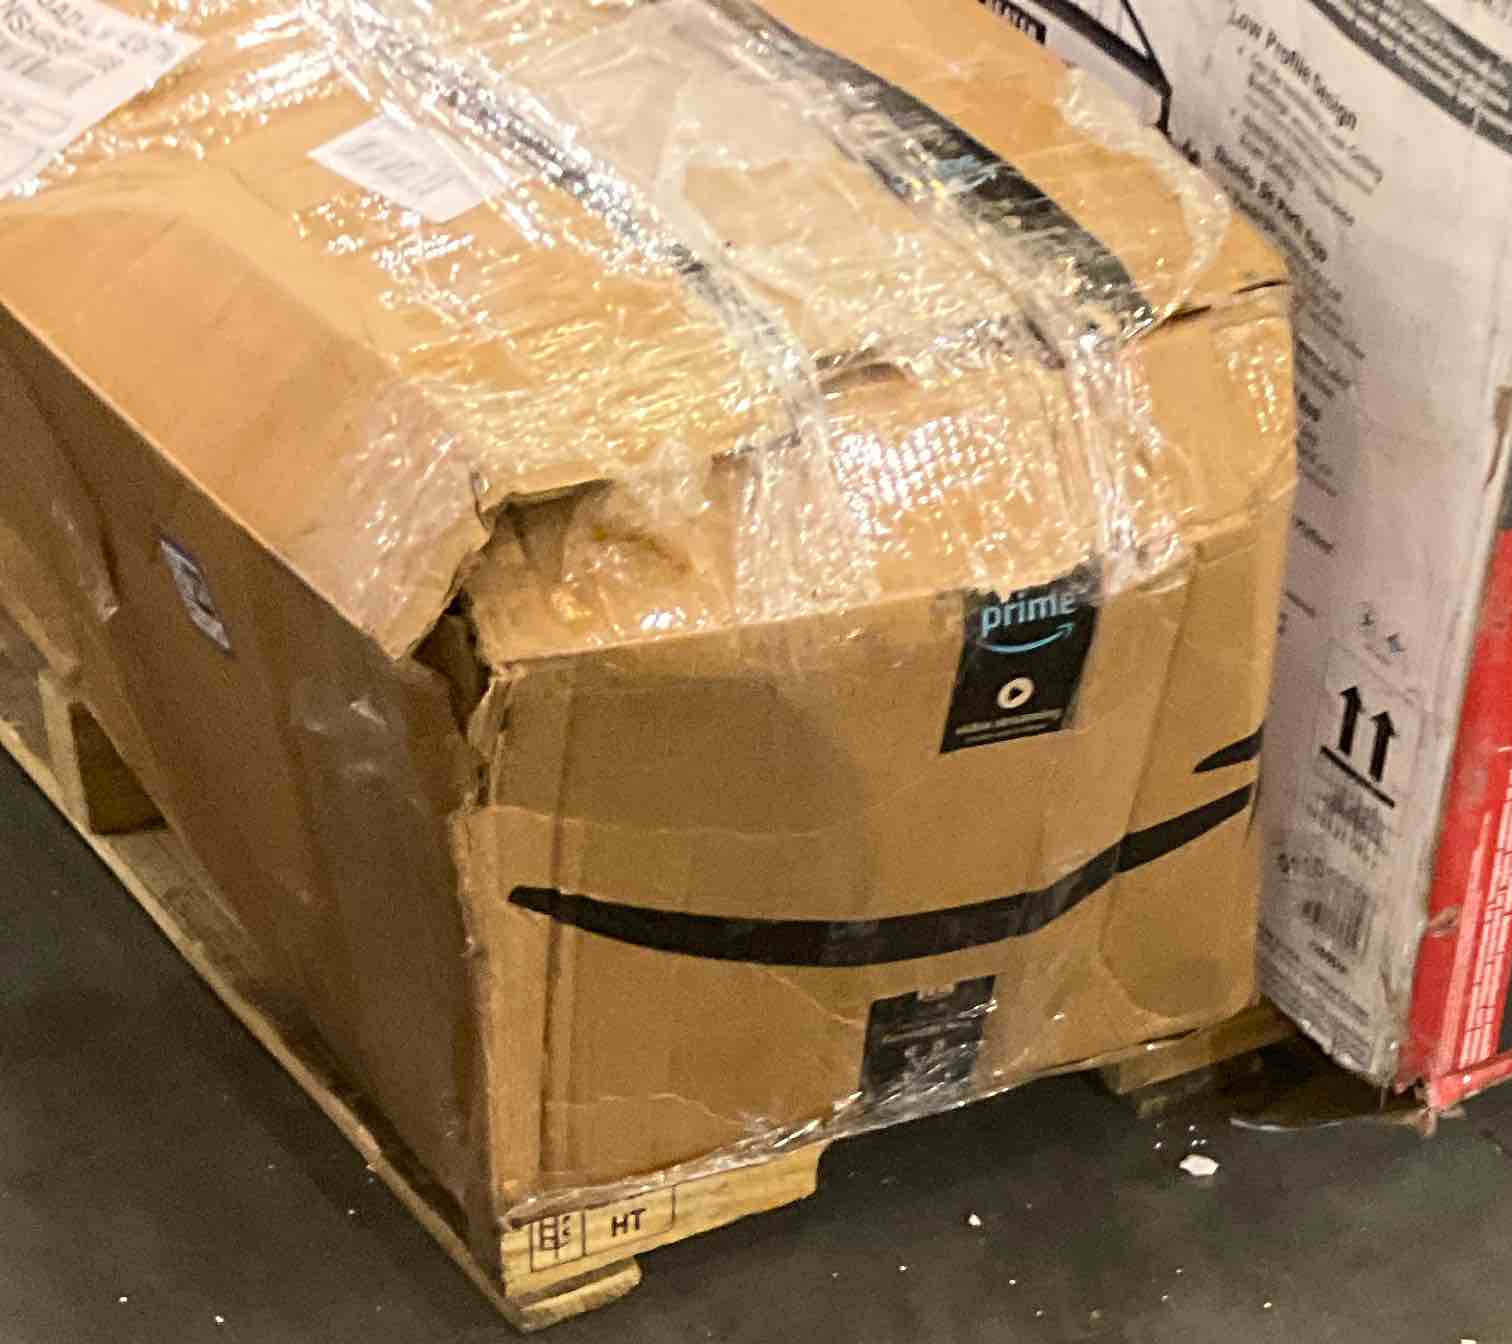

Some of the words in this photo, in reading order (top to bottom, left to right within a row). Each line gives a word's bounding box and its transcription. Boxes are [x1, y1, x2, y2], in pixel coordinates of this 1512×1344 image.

[1264, 29, 1312, 84] Profile
[1312, 72, 1357, 131] Design
[980, 591, 1078, 638] prime
[609, 1207, 647, 1238] HT
